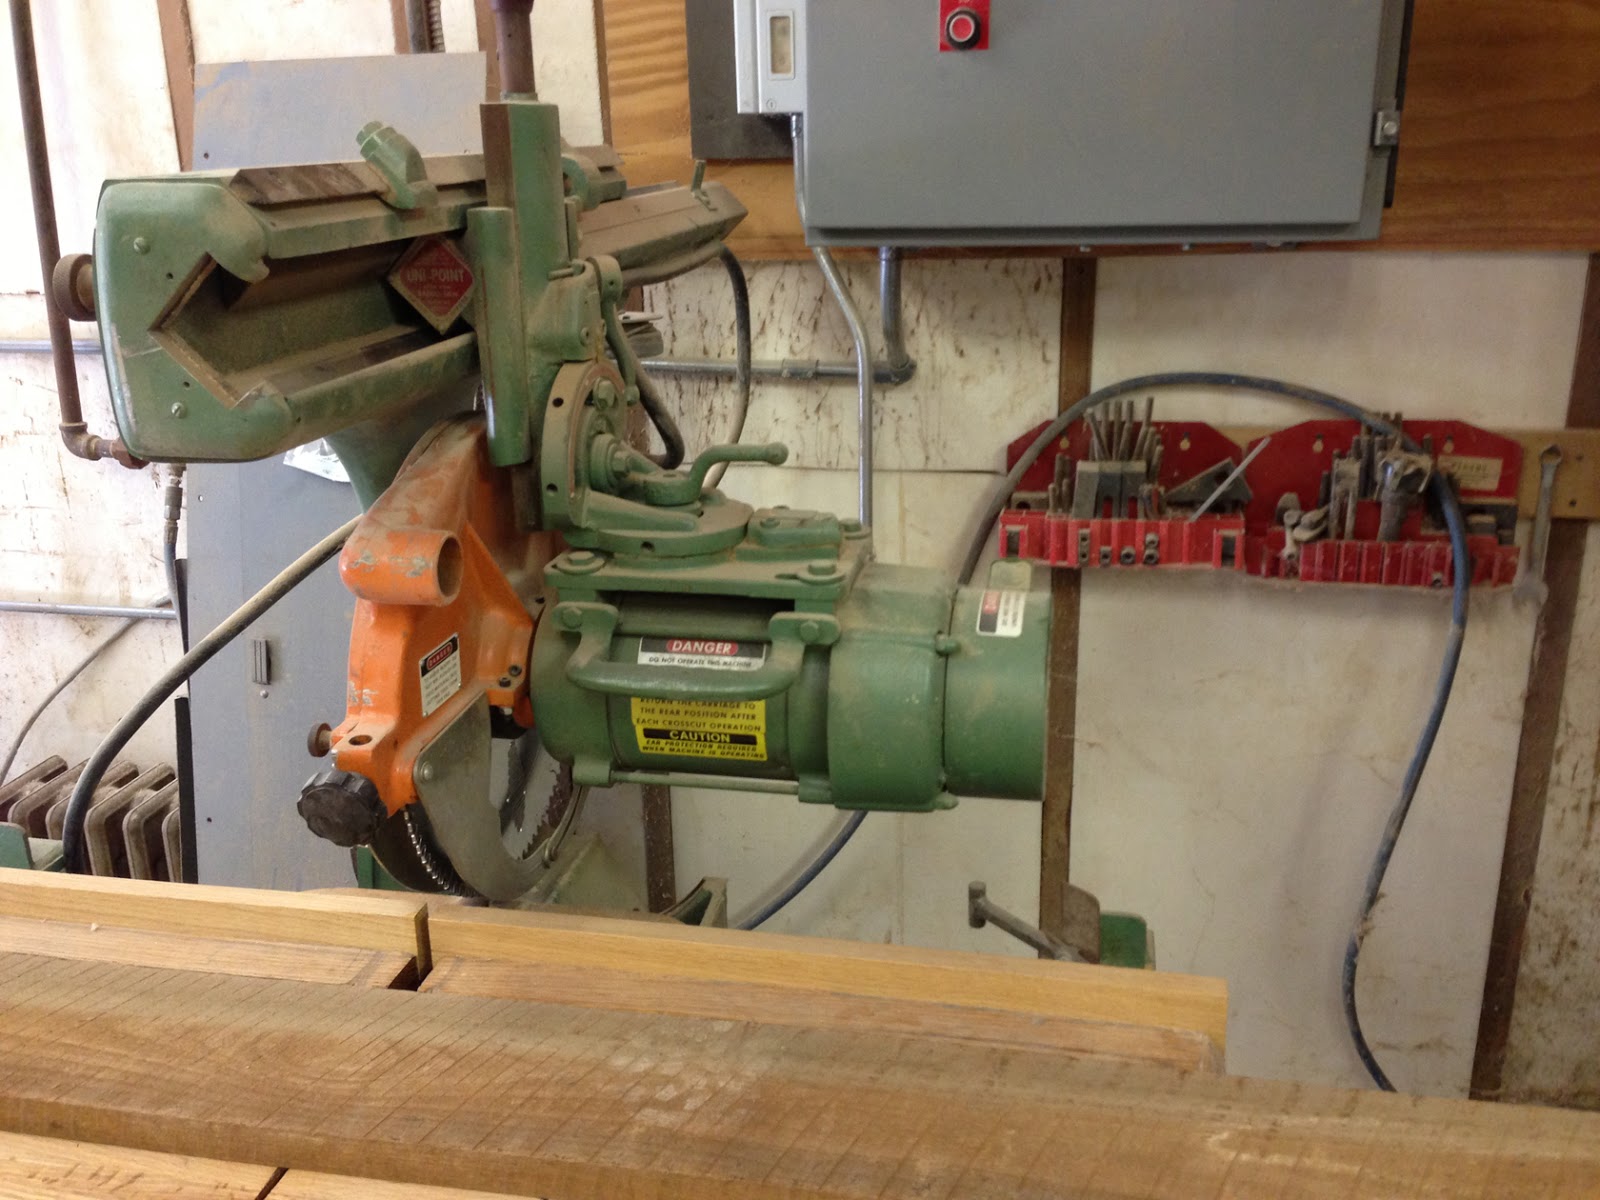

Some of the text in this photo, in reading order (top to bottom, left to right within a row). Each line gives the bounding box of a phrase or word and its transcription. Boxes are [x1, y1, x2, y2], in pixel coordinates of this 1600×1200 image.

[671, 640, 732, 655] DANGER
[722, 660, 752, 668] MACHINE
[695, 701, 741, 709] CARRIAGE
[744, 702, 756, 710] TO
[659, 708, 681, 716] REAR
[684, 710, 728, 719] POSITION
[731, 712, 757, 720] AFTER
[662, 719, 707, 729] CROSSCUT
[710, 722, 762, 732] OPERATION
[669, 730, 731, 743] CAUTION
[664, 740, 714, 749] PROTECTION
[717, 744, 757, 752] REQUIRED
[720, 750, 765, 759] OPERATING
